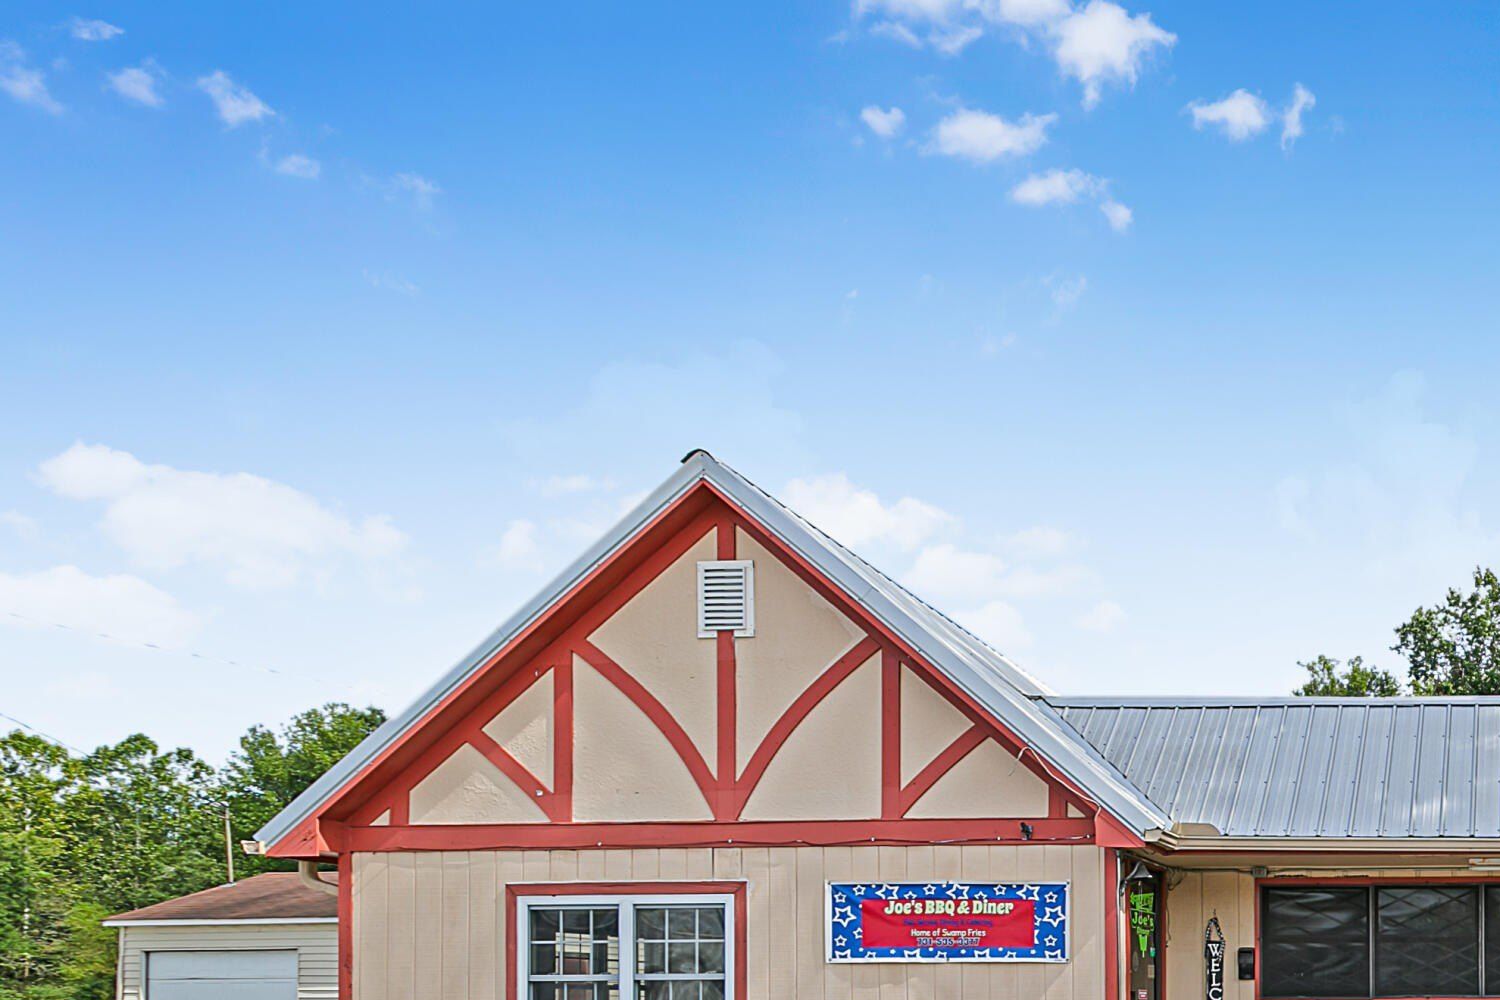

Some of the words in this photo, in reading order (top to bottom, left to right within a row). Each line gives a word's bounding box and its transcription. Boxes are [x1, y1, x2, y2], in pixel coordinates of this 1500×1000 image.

[884, 900, 923, 915] Joe's
[924, 900, 955, 917] BBQ
[957, 901, 971, 915] &
[972, 899, 1014, 915] Diner
[910, 928, 931, 937] Home
[931, 927, 941, 937] of
[941, 928, 967, 938] Swamp
[967, 928, 987, 937] Fries
